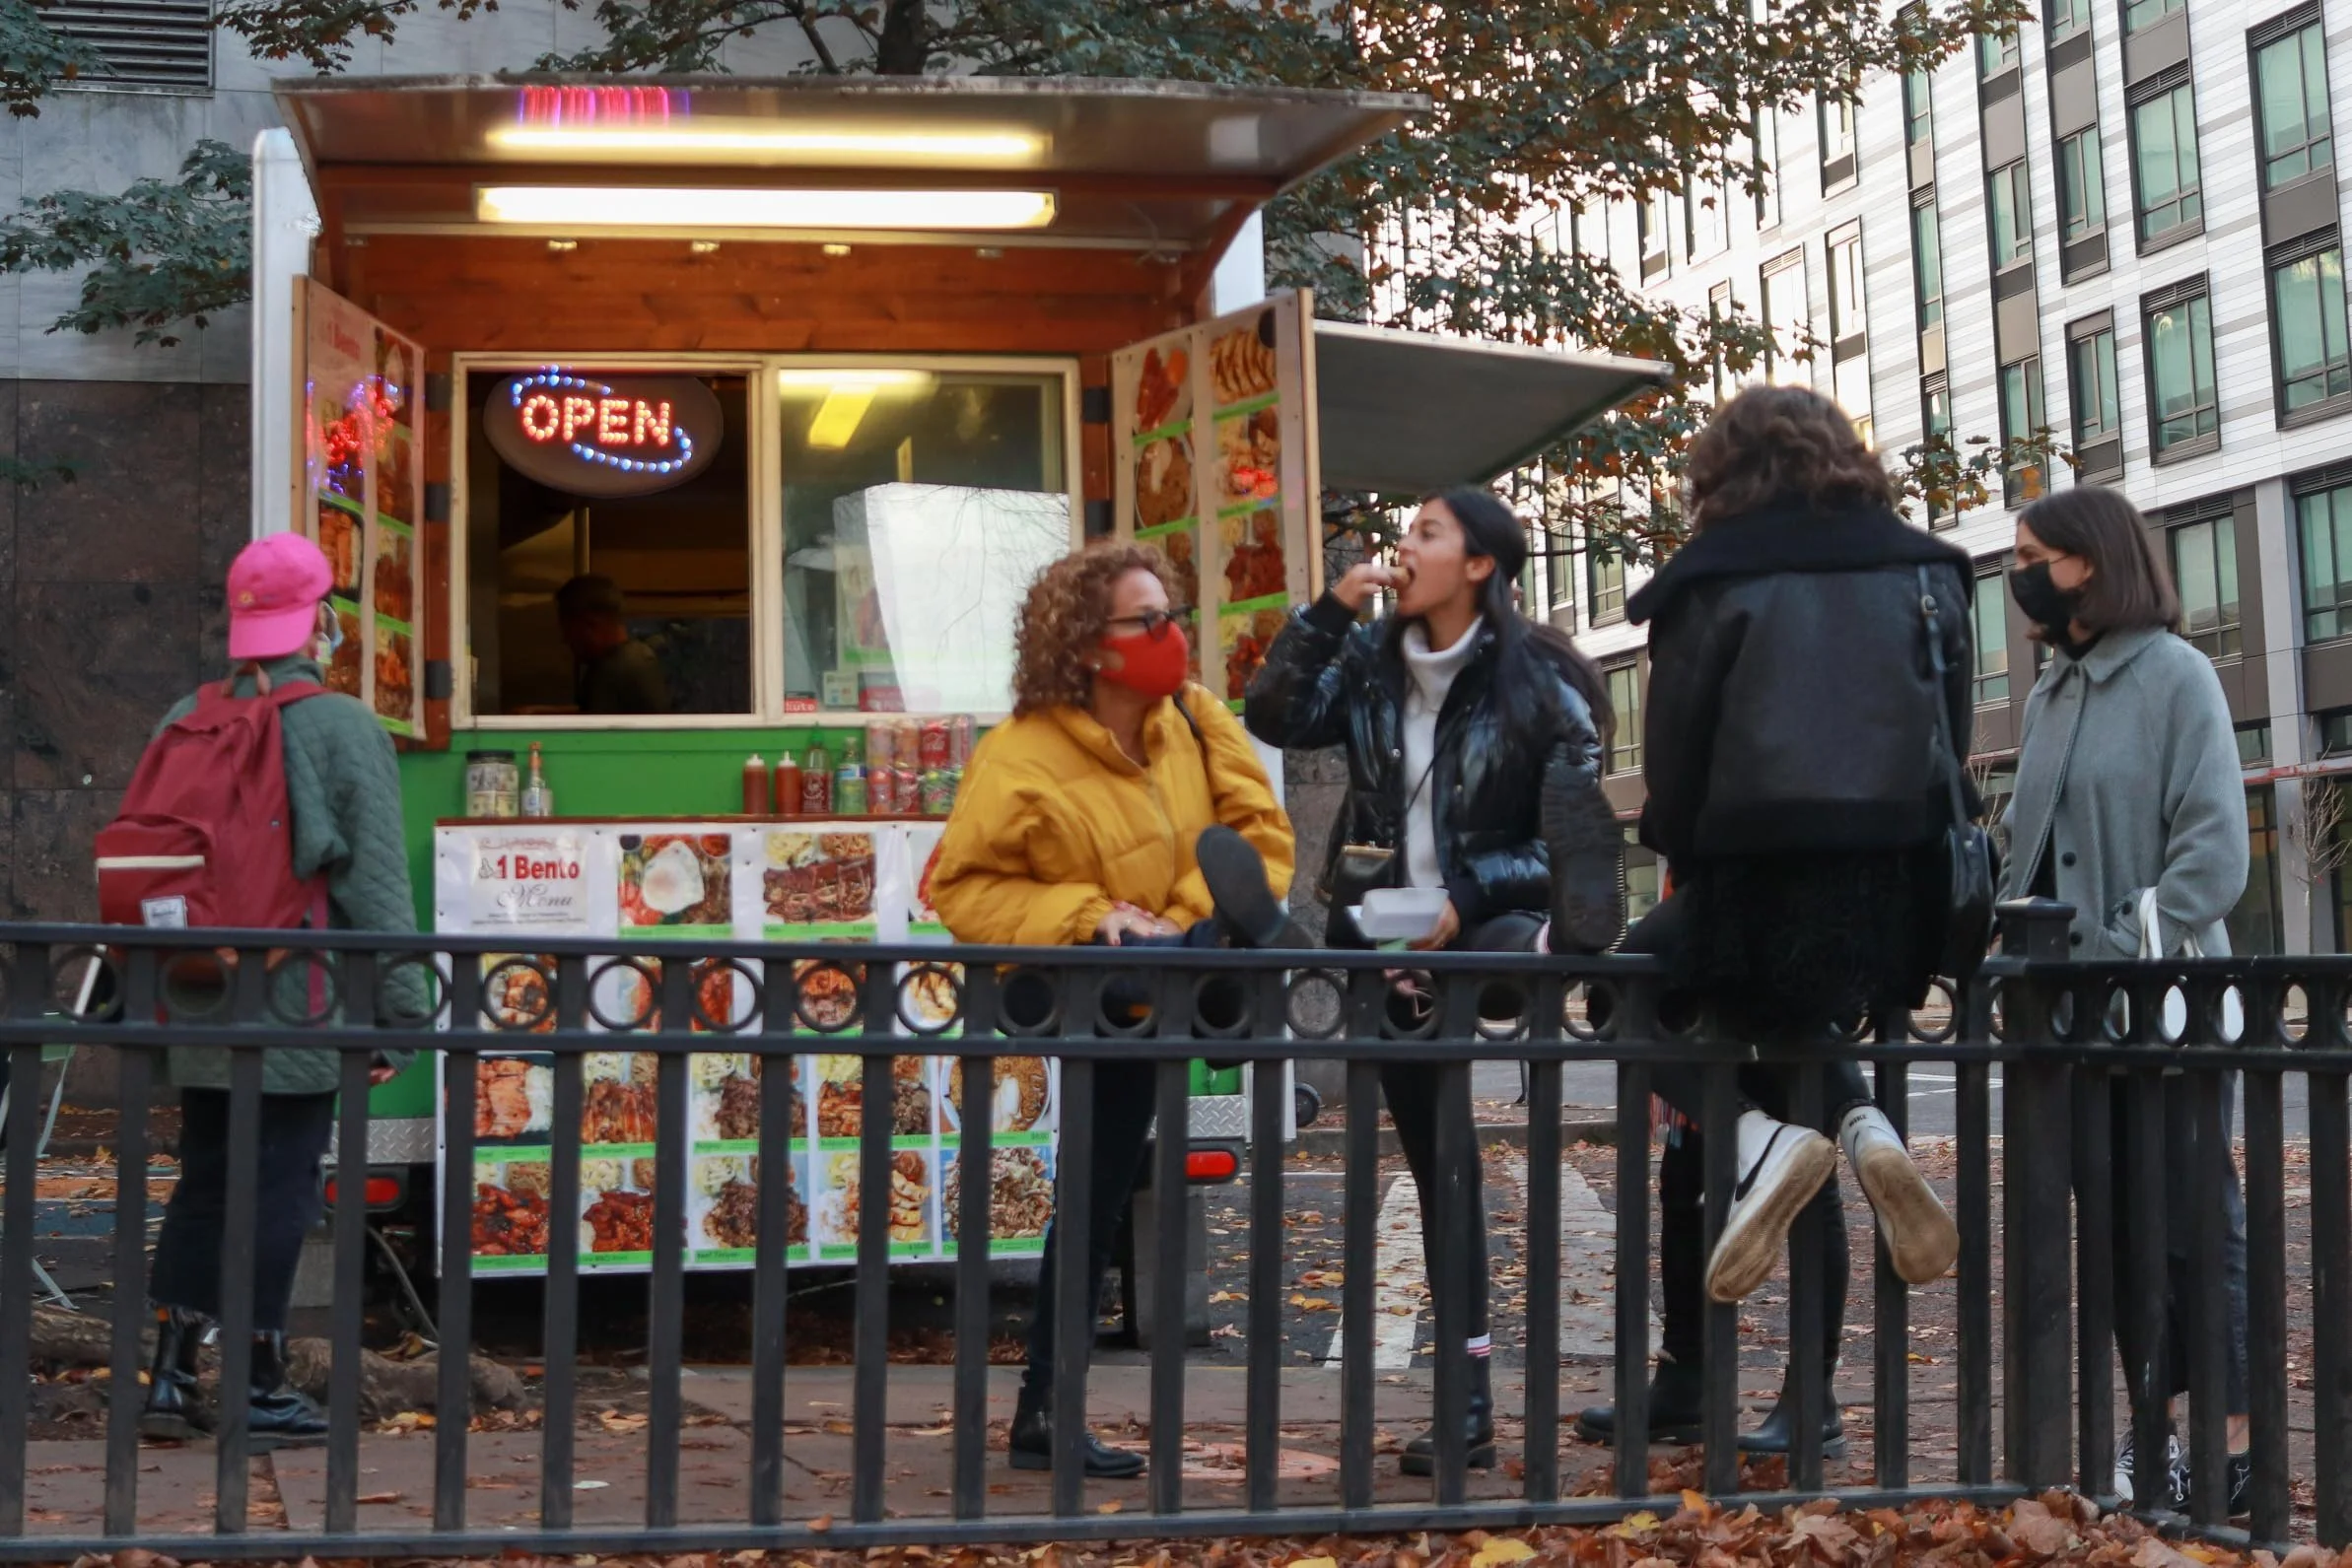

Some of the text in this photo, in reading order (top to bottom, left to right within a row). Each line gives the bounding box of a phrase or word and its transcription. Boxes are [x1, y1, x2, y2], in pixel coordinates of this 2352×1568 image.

[522, 395, 671, 445] OPEN
[497, 854, 580, 879] 1 Bento
[497, 884, 573, 907] Menu
